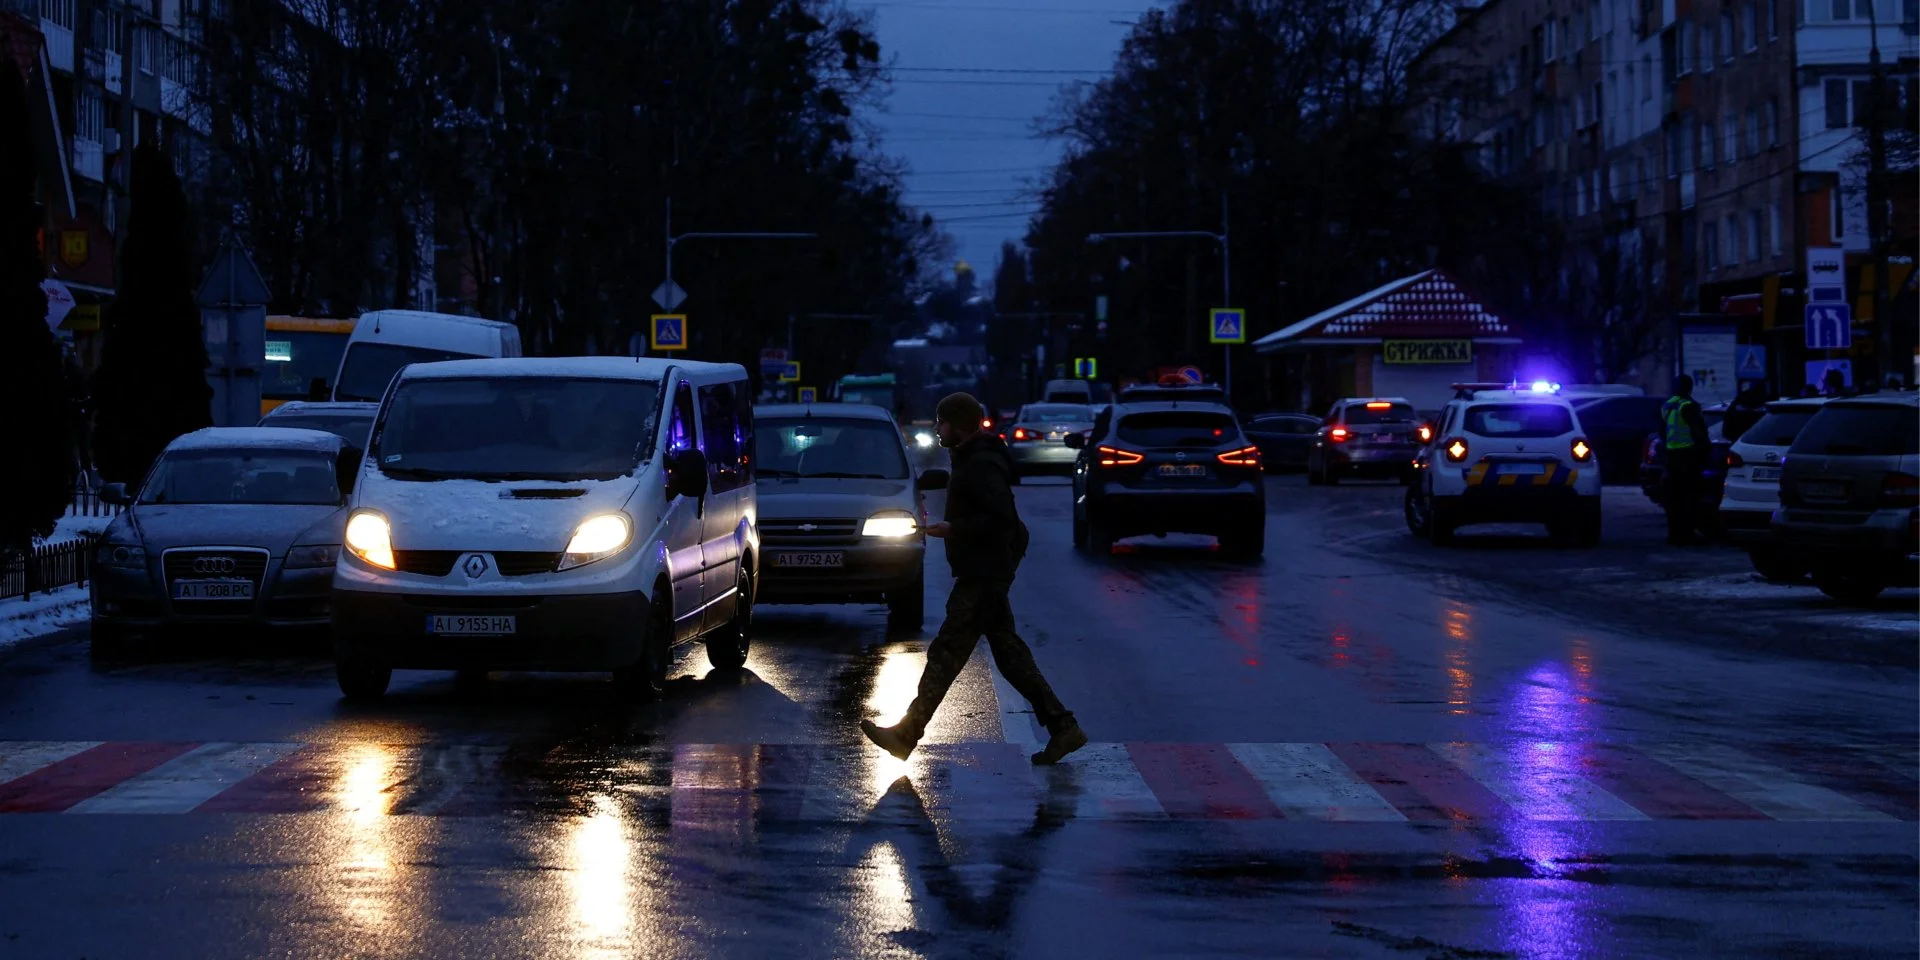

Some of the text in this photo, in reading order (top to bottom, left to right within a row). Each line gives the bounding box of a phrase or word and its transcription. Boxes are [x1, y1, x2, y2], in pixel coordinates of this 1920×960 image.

[1386, 341, 1469, 360] СТРИЖКА
[779, 554, 840, 565] AI 9752 AX
[182, 584, 250, 597] AI 1208 PC
[435, 617, 513, 632] AI 9155 HA
